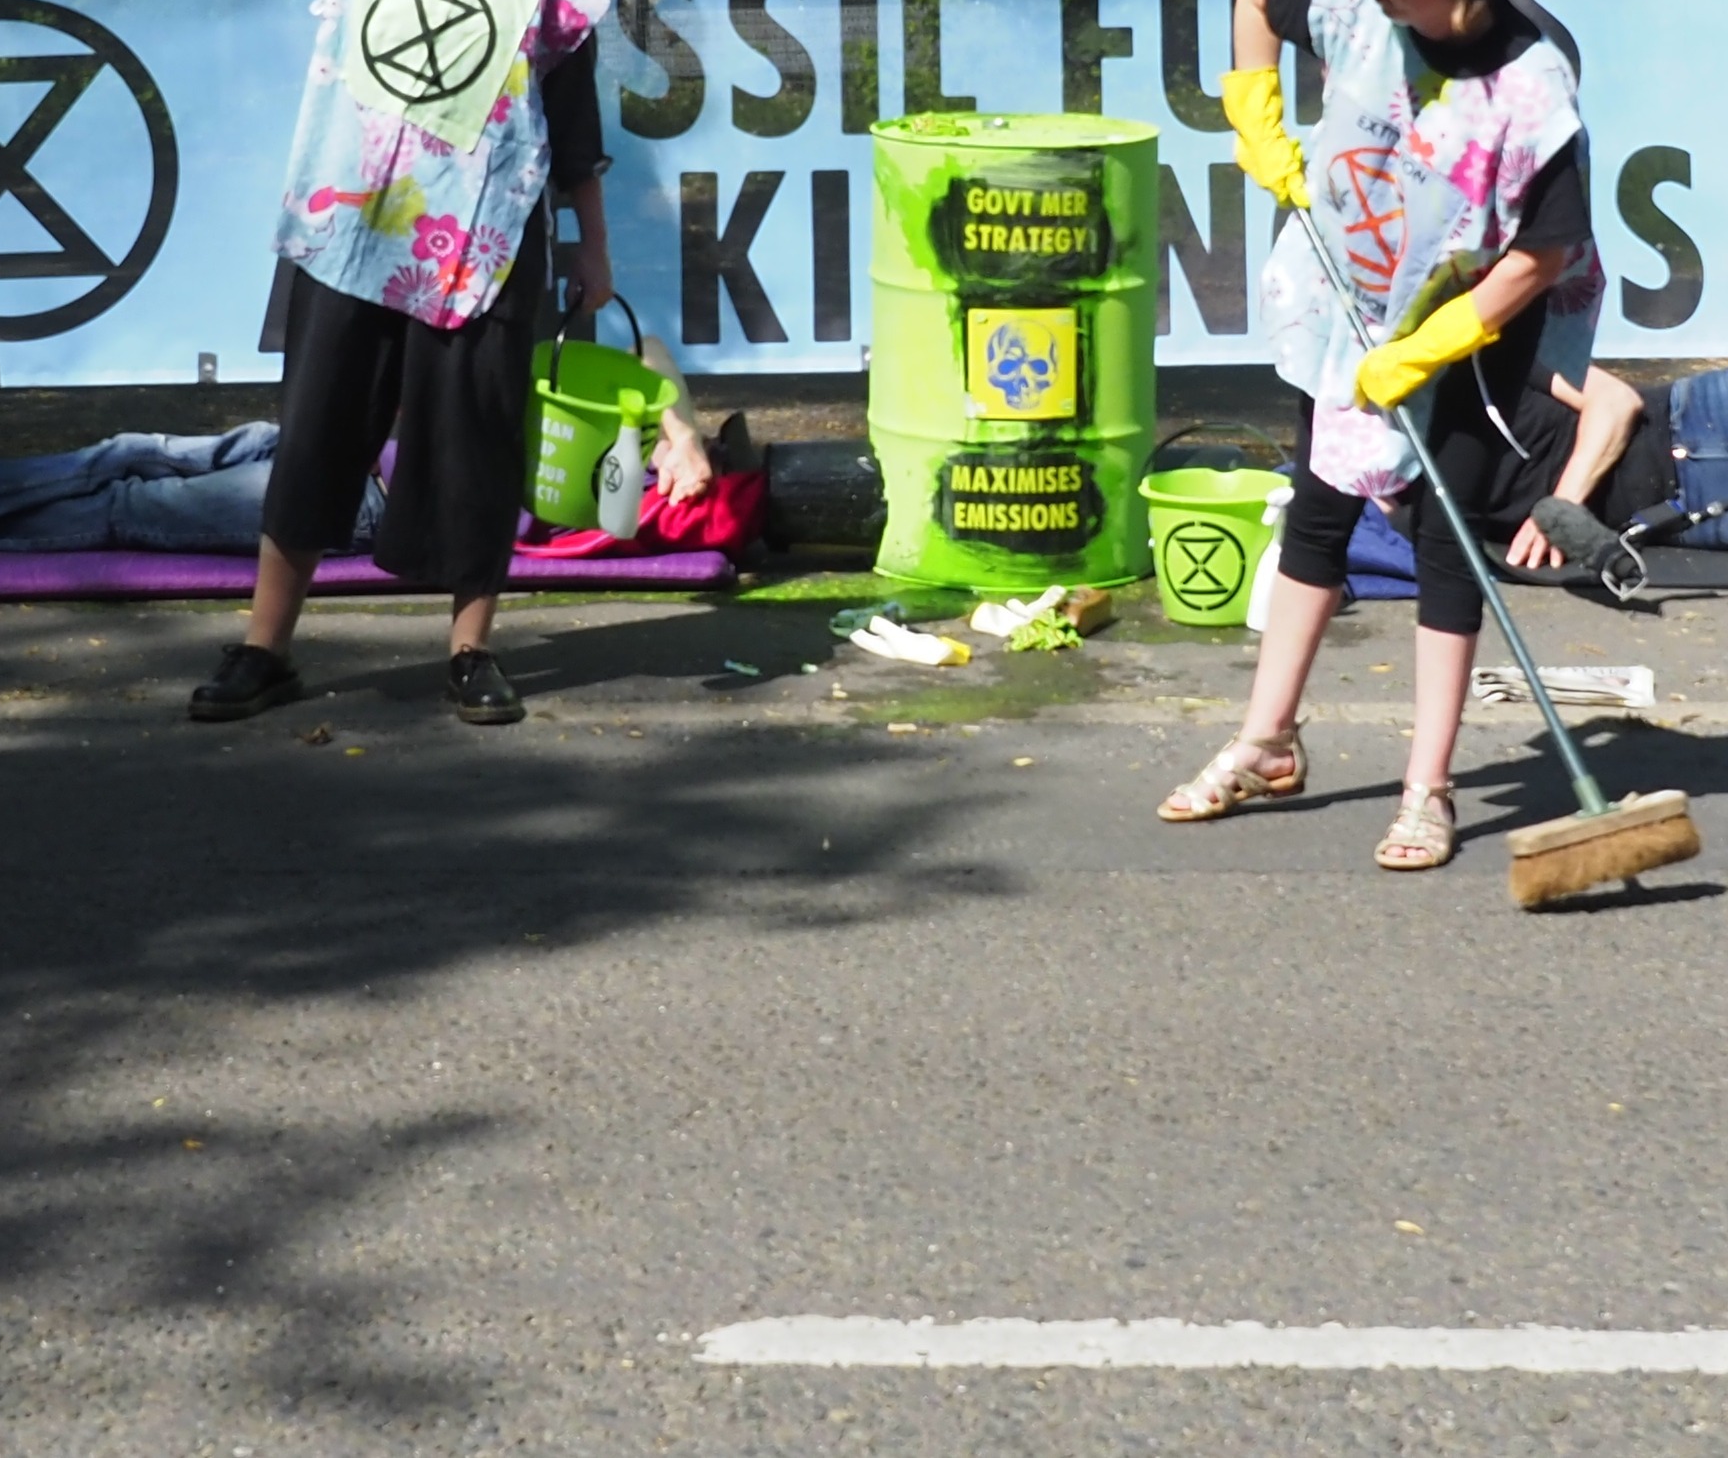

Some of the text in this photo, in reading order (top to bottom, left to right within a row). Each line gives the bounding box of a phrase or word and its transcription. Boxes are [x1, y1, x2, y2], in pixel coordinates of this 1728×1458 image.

[967, 187, 1088, 217] GOVT MER
[964, 223, 1089, 256] STRATEGY
[950, 463, 1083, 494] MAXIMISES
[953, 500, 1080, 531] EMISSIONS
